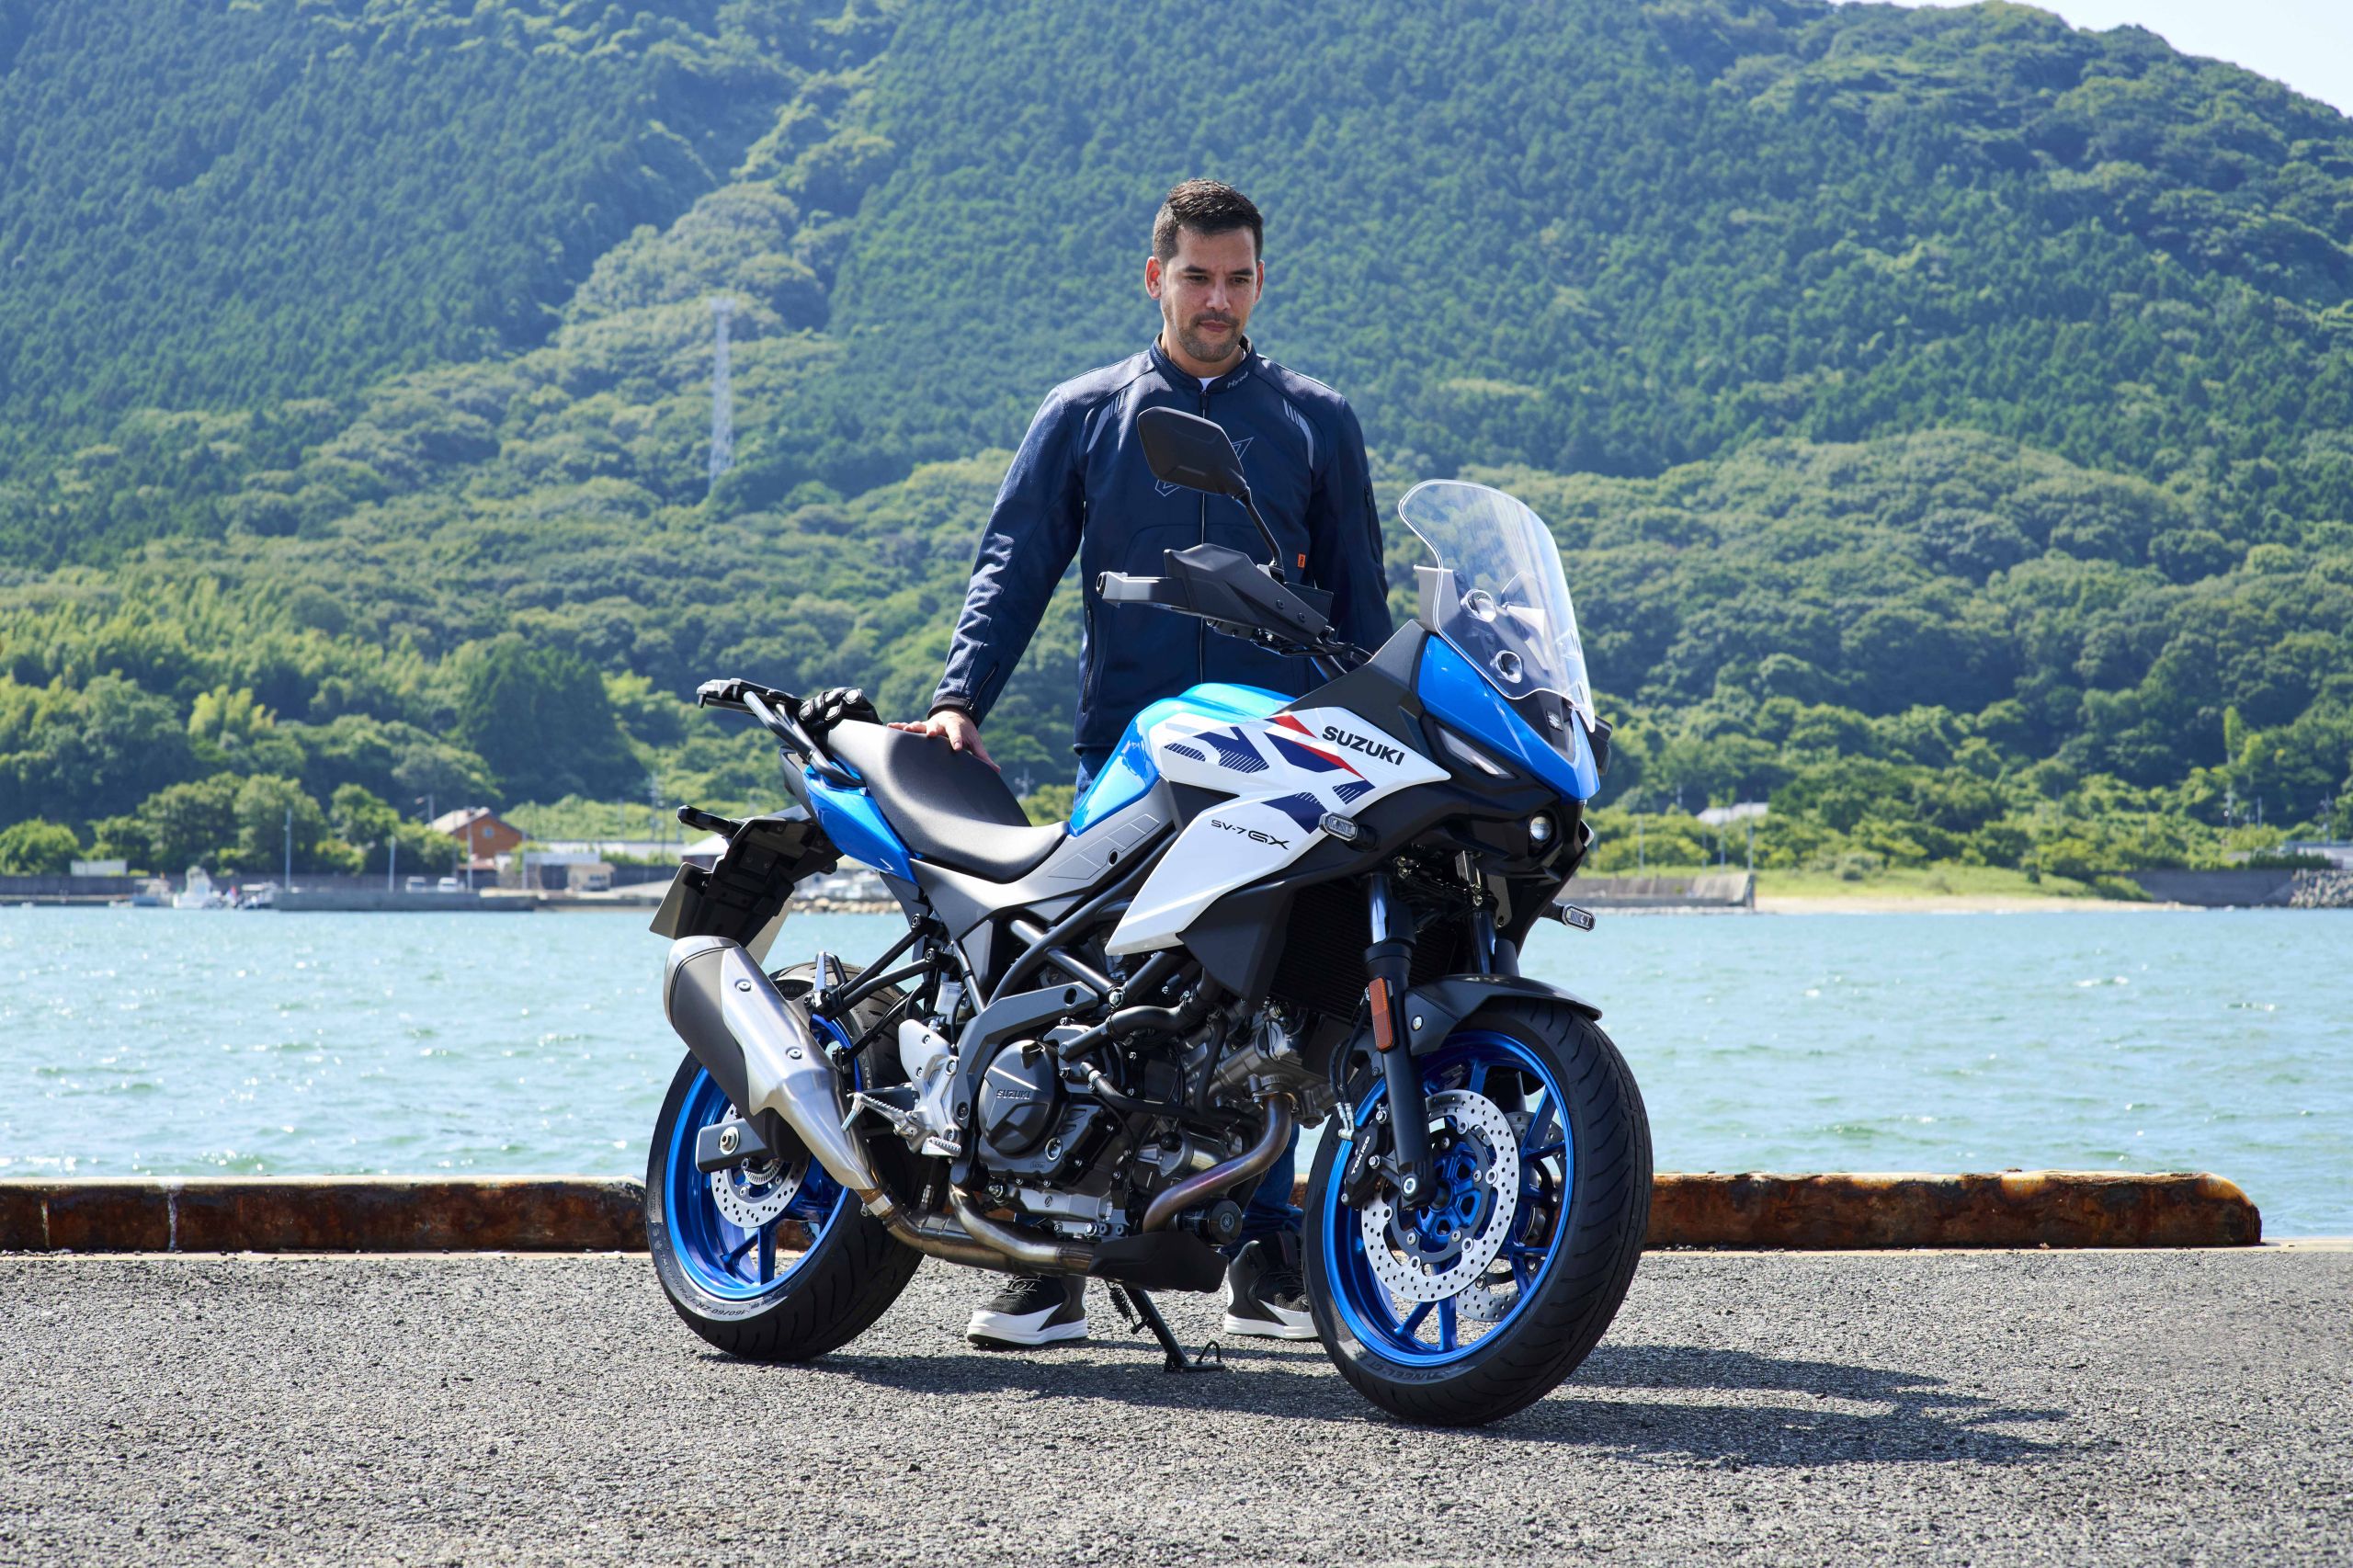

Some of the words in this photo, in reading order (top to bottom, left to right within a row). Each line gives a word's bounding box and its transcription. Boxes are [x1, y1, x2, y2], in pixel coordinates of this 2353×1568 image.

[1322, 725, 1405, 766] SUZUKI
[995, 1089, 1031, 1100] SUZUKI
[1351, 1135, 1370, 1175] TOKICO
